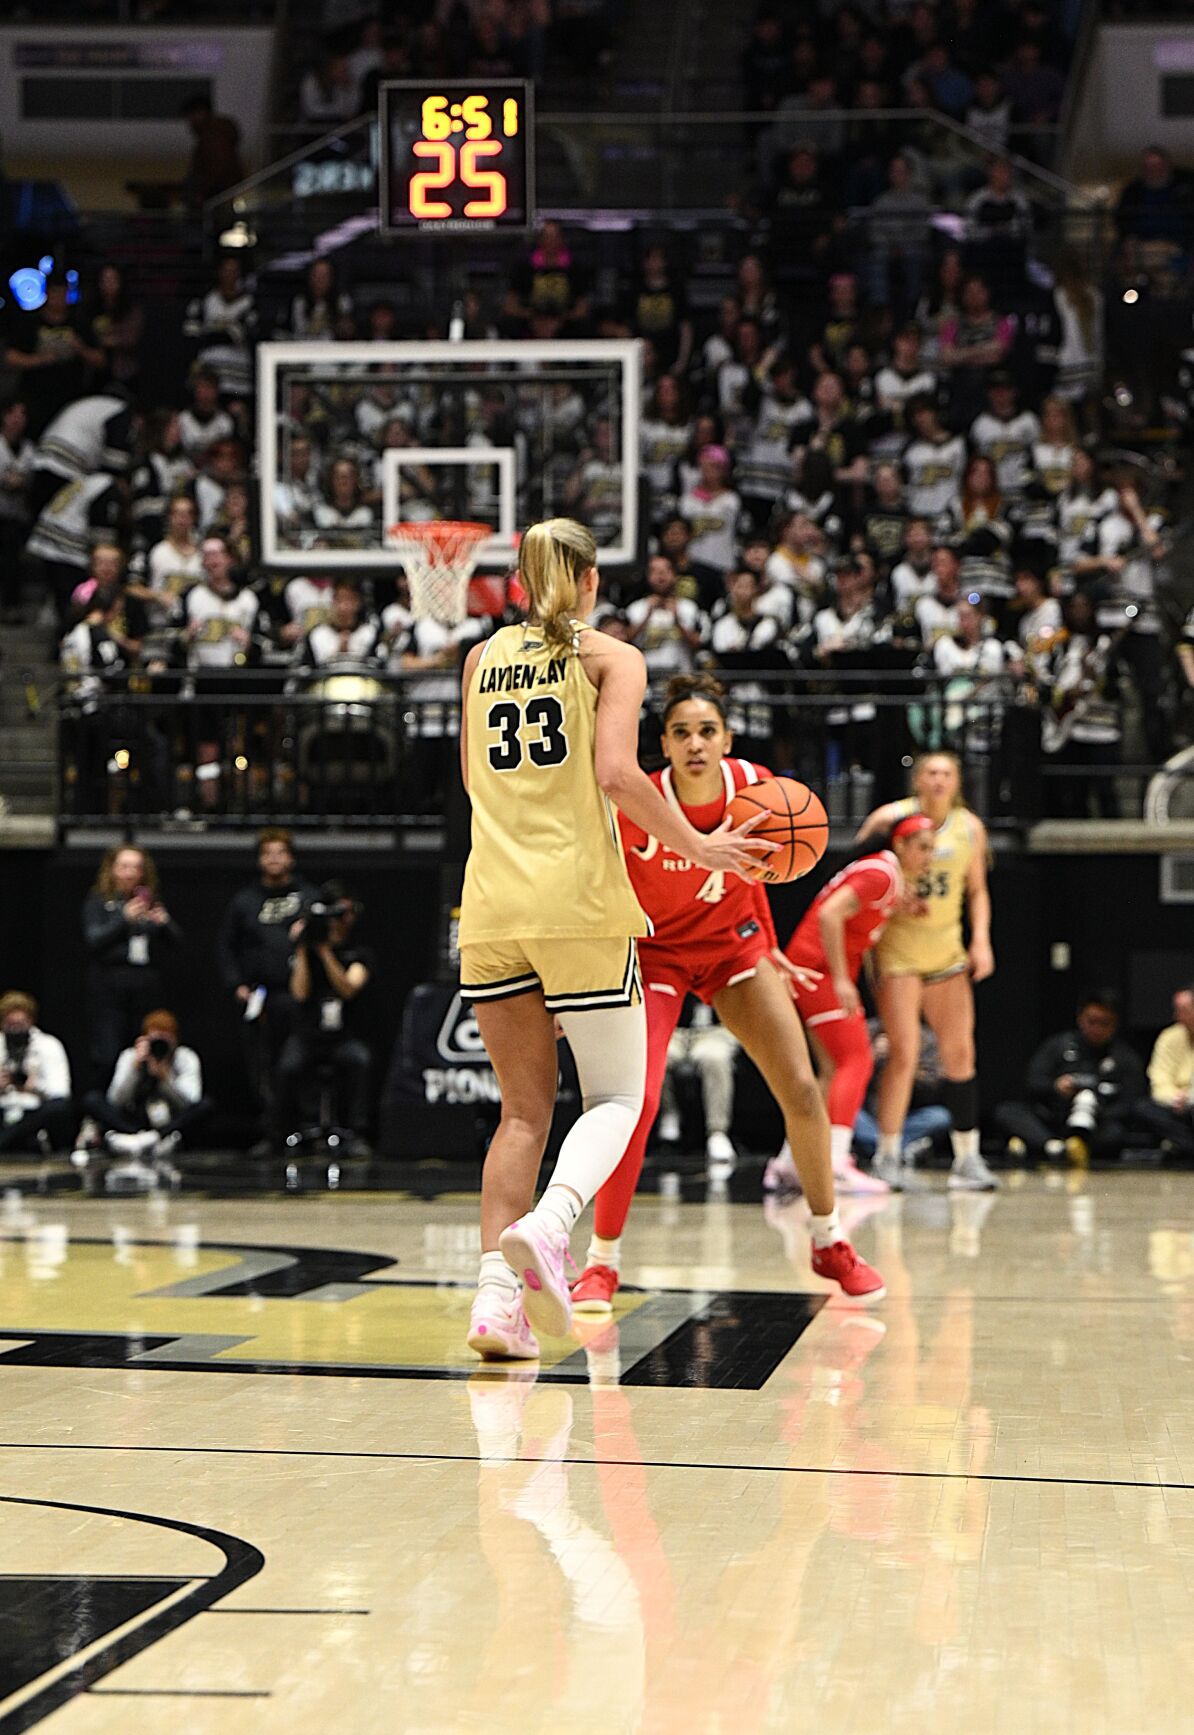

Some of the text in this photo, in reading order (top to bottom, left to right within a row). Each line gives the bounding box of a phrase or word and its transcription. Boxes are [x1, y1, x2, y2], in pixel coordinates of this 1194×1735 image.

[422, 95, 518, 141] 6:51
[409, 140, 507, 218] 25
[487, 695, 570, 773] 33
[695, 871, 727, 903] 4
